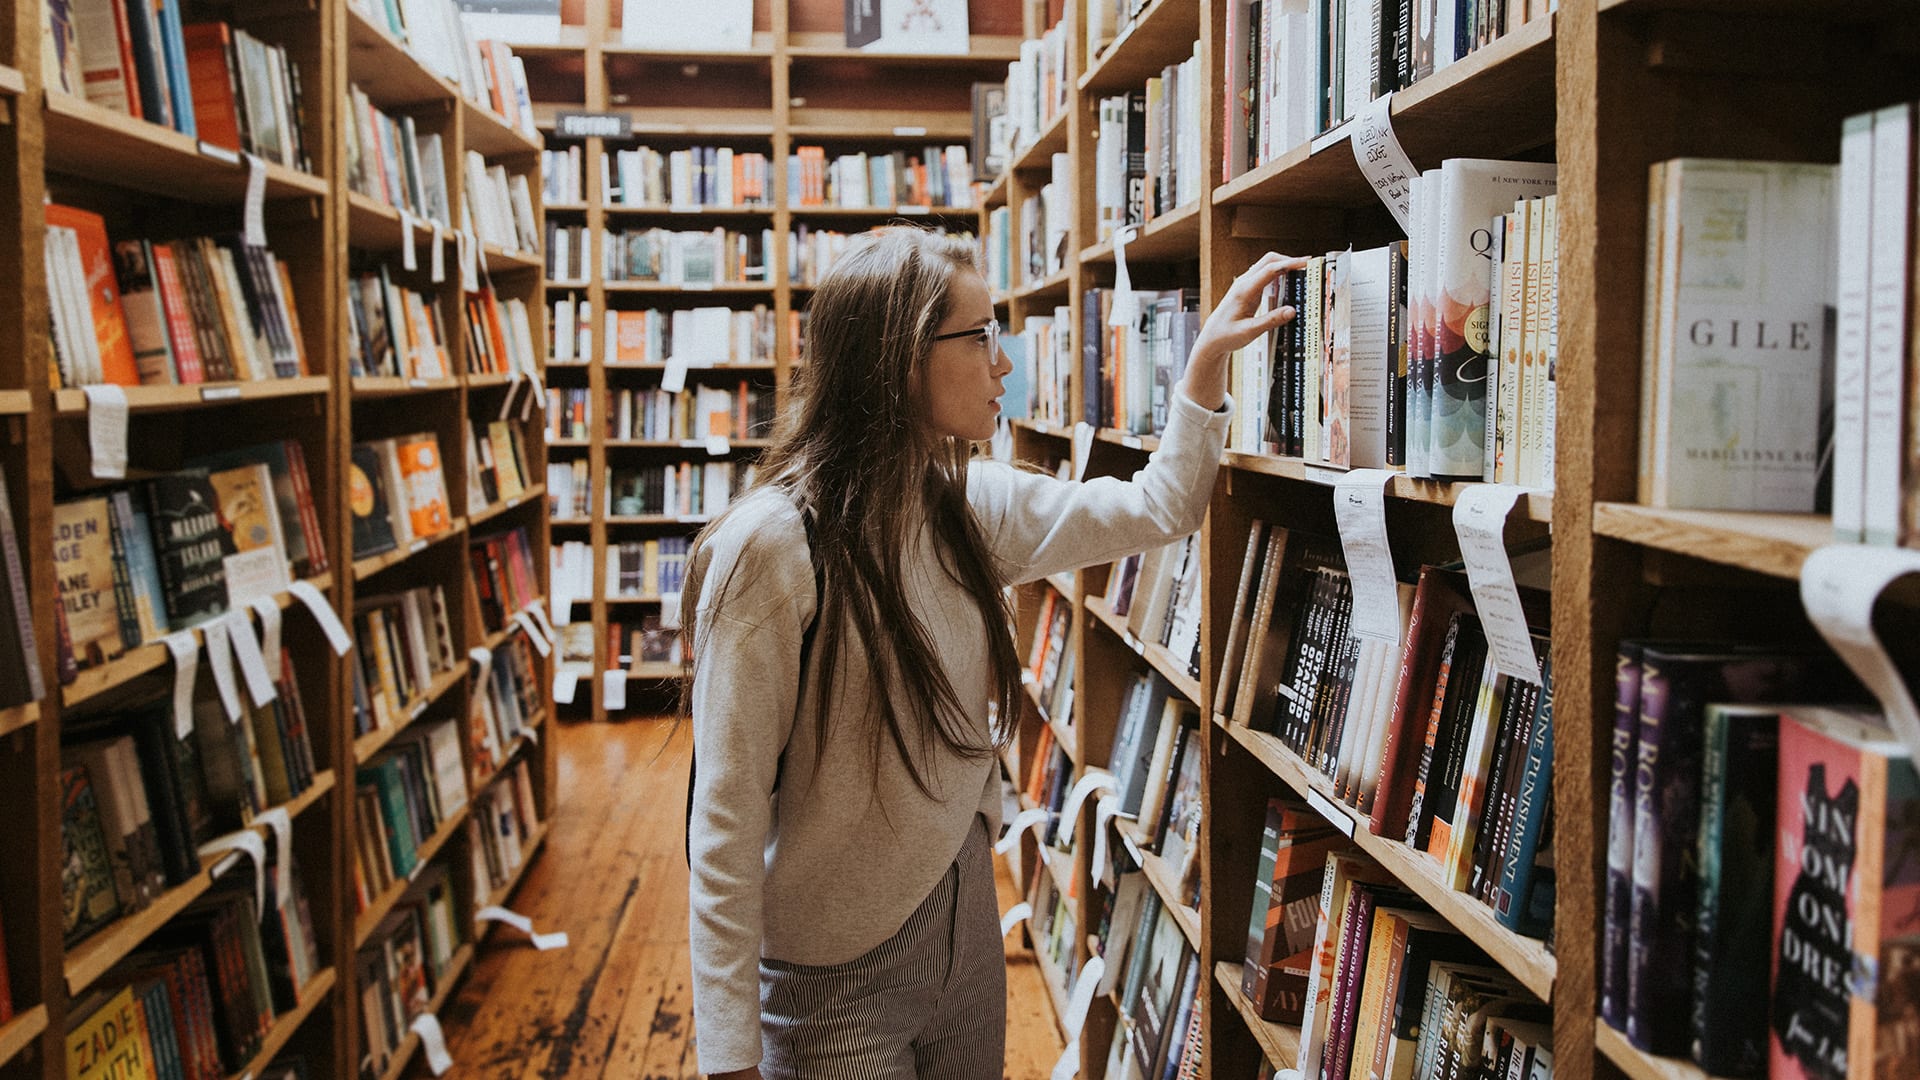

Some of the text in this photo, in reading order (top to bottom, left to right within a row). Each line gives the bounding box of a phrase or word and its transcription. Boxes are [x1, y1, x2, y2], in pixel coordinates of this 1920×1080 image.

[1370, 56, 1382, 85] EDGE
[1397, 47, 1408, 78] EDGE
[1390, 251, 1398, 314] Monument
[1508, 261, 1521, 335] ISHMAEL
[1526, 263, 1538, 338] ISHMAEL
[1540, 259, 1551, 337] ISHMAEL
[1294, 326, 1302, 348] FAIL
[1690, 318, 1812, 351] GILE
[1293, 360, 1301, 439] MATTHEW QUICK
[1486, 371, 1495, 451] Anna Quindlen
[1505, 371, 1516, 445] DANIEL QUINN
[1522, 374, 1532, 450] DANIEL QUINN
[1535, 373, 1545, 451] DANIEL QUINN
[1684, 446, 1817, 464] MARILYNNE RO
[59, 572, 89, 594] ANE
[64, 590, 101, 613] ILEY
[1294, 646, 1316, 719] OTARED
[1302, 650, 1324, 724] OTARED
[1390, 614, 1420, 723] Devil in Jerusalem
[1504, 697, 1515, 731] RAKHA
[1520, 687, 1529, 708] WHY
[1528, 691, 1537, 712] WHY
[1380, 733, 1394, 767] NAOMI
[1513, 717, 1523, 740] CAME
[1521, 721, 1531, 744] CAME
[1609, 727, 1631, 806] ROSE
[1635, 738, 1659, 822] ROSE
[1483, 769, 1500, 835] CROCODILES
[1504, 754, 1542, 884] PUNISHMENT
[1798, 791, 1851, 847] NIN
[1286, 891, 1322, 934] FOU
[1368, 914, 1384, 970] KNOW YOUR
[1378, 925, 1393, 983] KNOW YOUR
[1271, 989, 1300, 1013] AY
[1325, 906, 1352, 1067] UNRESTORED WOMAN SHOBHA
[1334, 915, 1364, 1077] UNRESTORED WOMAN SHOBHA
[1387, 971, 1396, 993] RON
[1382, 995, 1392, 1022] RASH
[1431, 988, 1443, 1022] Ron
[1443, 998, 1456, 1033] THE
[74, 1004, 135, 1076] ZADIE
[1375, 1024, 1388, 1065] READER
[1455, 1011, 1469, 1046] THE
[103, 1041, 141, 1080] ITH
[1511, 1048, 1523, 1070] THE
